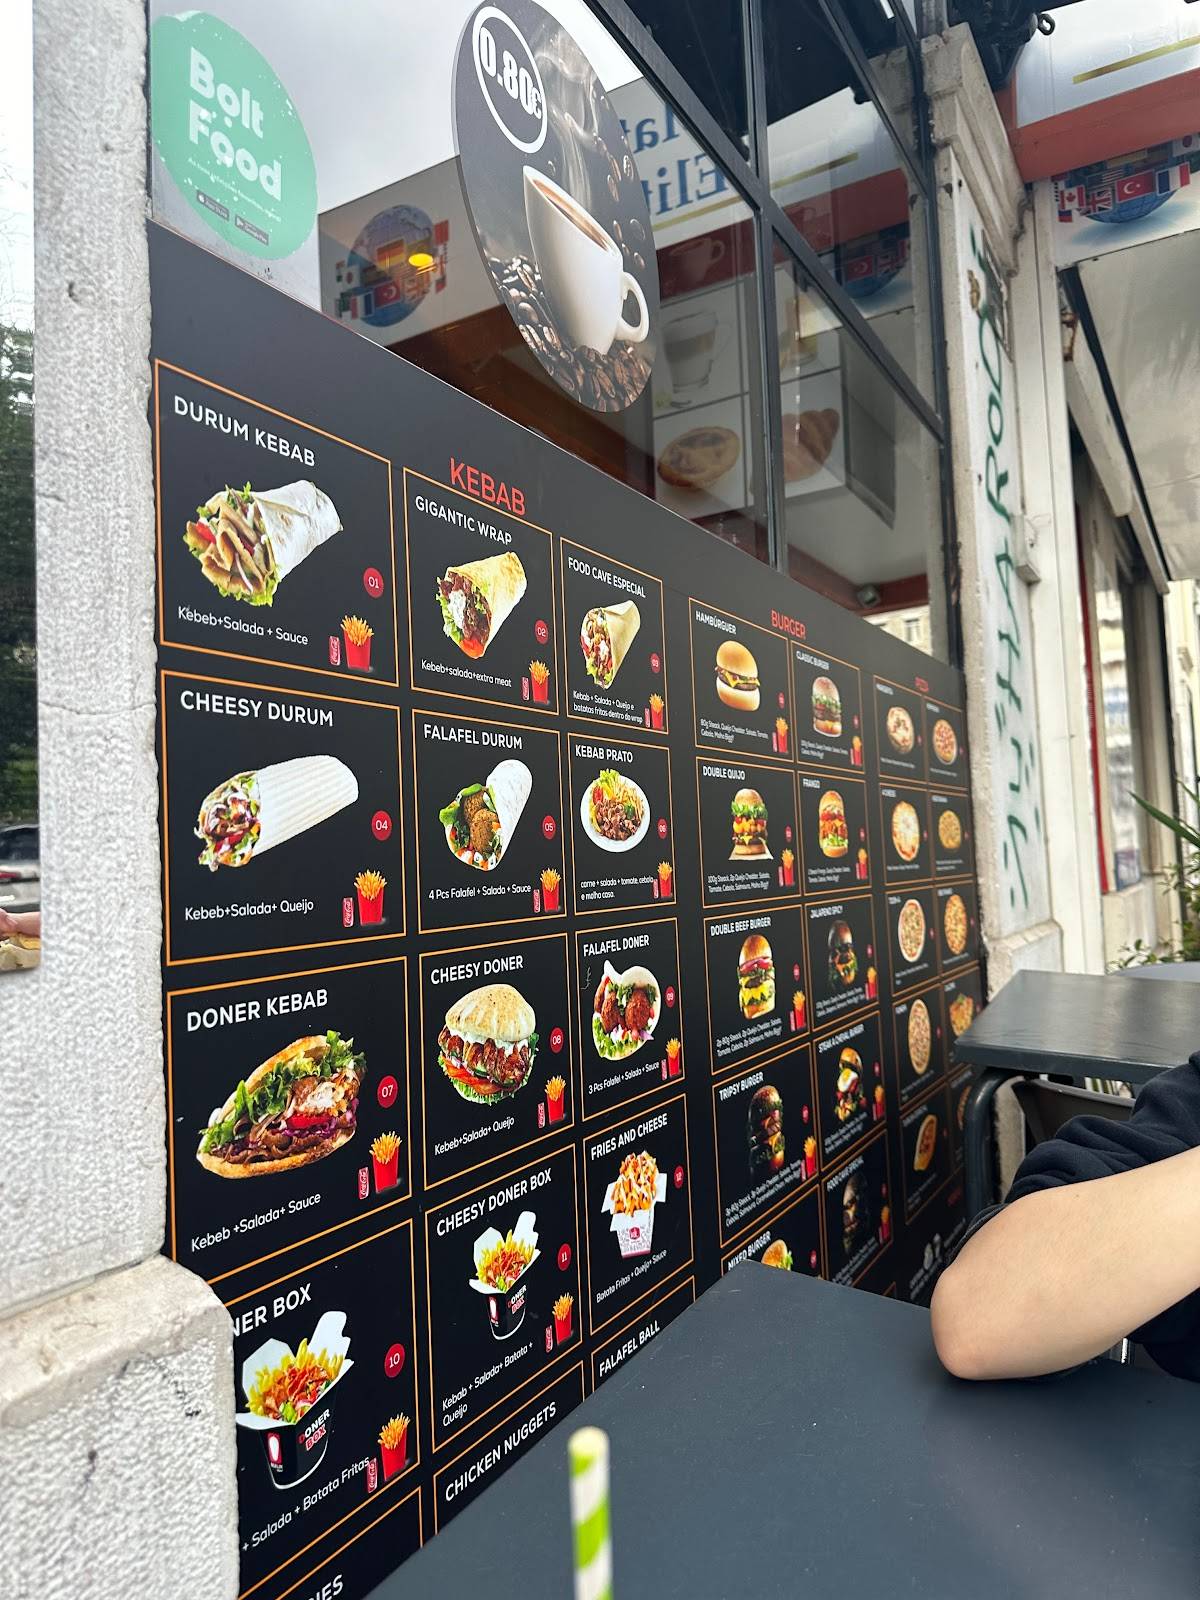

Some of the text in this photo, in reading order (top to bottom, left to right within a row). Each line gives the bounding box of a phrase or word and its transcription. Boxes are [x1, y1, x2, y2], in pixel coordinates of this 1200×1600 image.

[190, 46, 264, 138] Bolt
[189, 99, 281, 202] Food
[174, 395, 315, 466] DURUM KEBAB
[450, 458, 526, 516] KEBAB
[415, 495, 512, 545] GIGANTIC WRAP
[368, 576, 379, 589] 01
[568, 557, 646, 598] FOOD CAVE ESPECIAL
[276, 627, 308, 645] Sauce
[771, 610, 806, 639] BURGER
[494, 677, 511, 687] meat
[180, 690, 333, 727] CHEESY DURUM
[424, 724, 522, 750] FALAFEL DURUM
[575, 745, 633, 763] KEBAB PRATO
[703, 766, 727, 779] DOUBLE
[375, 820, 388, 831] 04
[545, 823, 554, 832] 05
[429, 890, 435, 900] 4
[436, 889, 449, 900] Pcs
[451, 888, 476, 898] Falafel
[483, 886, 505, 895] Salada
[512, 883, 531, 893] Sauce
[280, 899, 314, 913] Queijo
[711, 923, 735, 937] DOUBLE
[735, 920, 749, 933] BEEF
[583, 934, 649, 957] FALAFEL DONER
[431, 955, 523, 985] CHEESY DONER
[186, 988, 328, 1032] DONER KEBAB
[382, 1084, 394, 1098] 07
[589, 1085, 593, 1095] 3
[493, 1116, 514, 1134] Queijo
[591, 1113, 667, 1160] FRIES AND CHEESE
[436, 1168, 552, 1237] CHEESY DONER BOX
[191, 1228, 230, 1252] Kebeb
[288, 1192, 321, 1214] Sauce
[273, 1283, 311, 1318] BOX
[389, 1352, 400, 1366] 10
[599, 1320, 660, 1377] FALAFEL BALL
[443, 1384, 468, 1411] Kebab
[504, 1343, 527, 1366] Batata
[443, 1403, 468, 1427] Queijo
[305, 1424, 326, 1451] BOX
[445, 1401, 557, 1502] CHICKEN NUGGETS
[252, 1512, 292, 1543] Salada
[303, 1479, 340, 1511] Batata
[341, 1456, 370, 1484] Fritas
